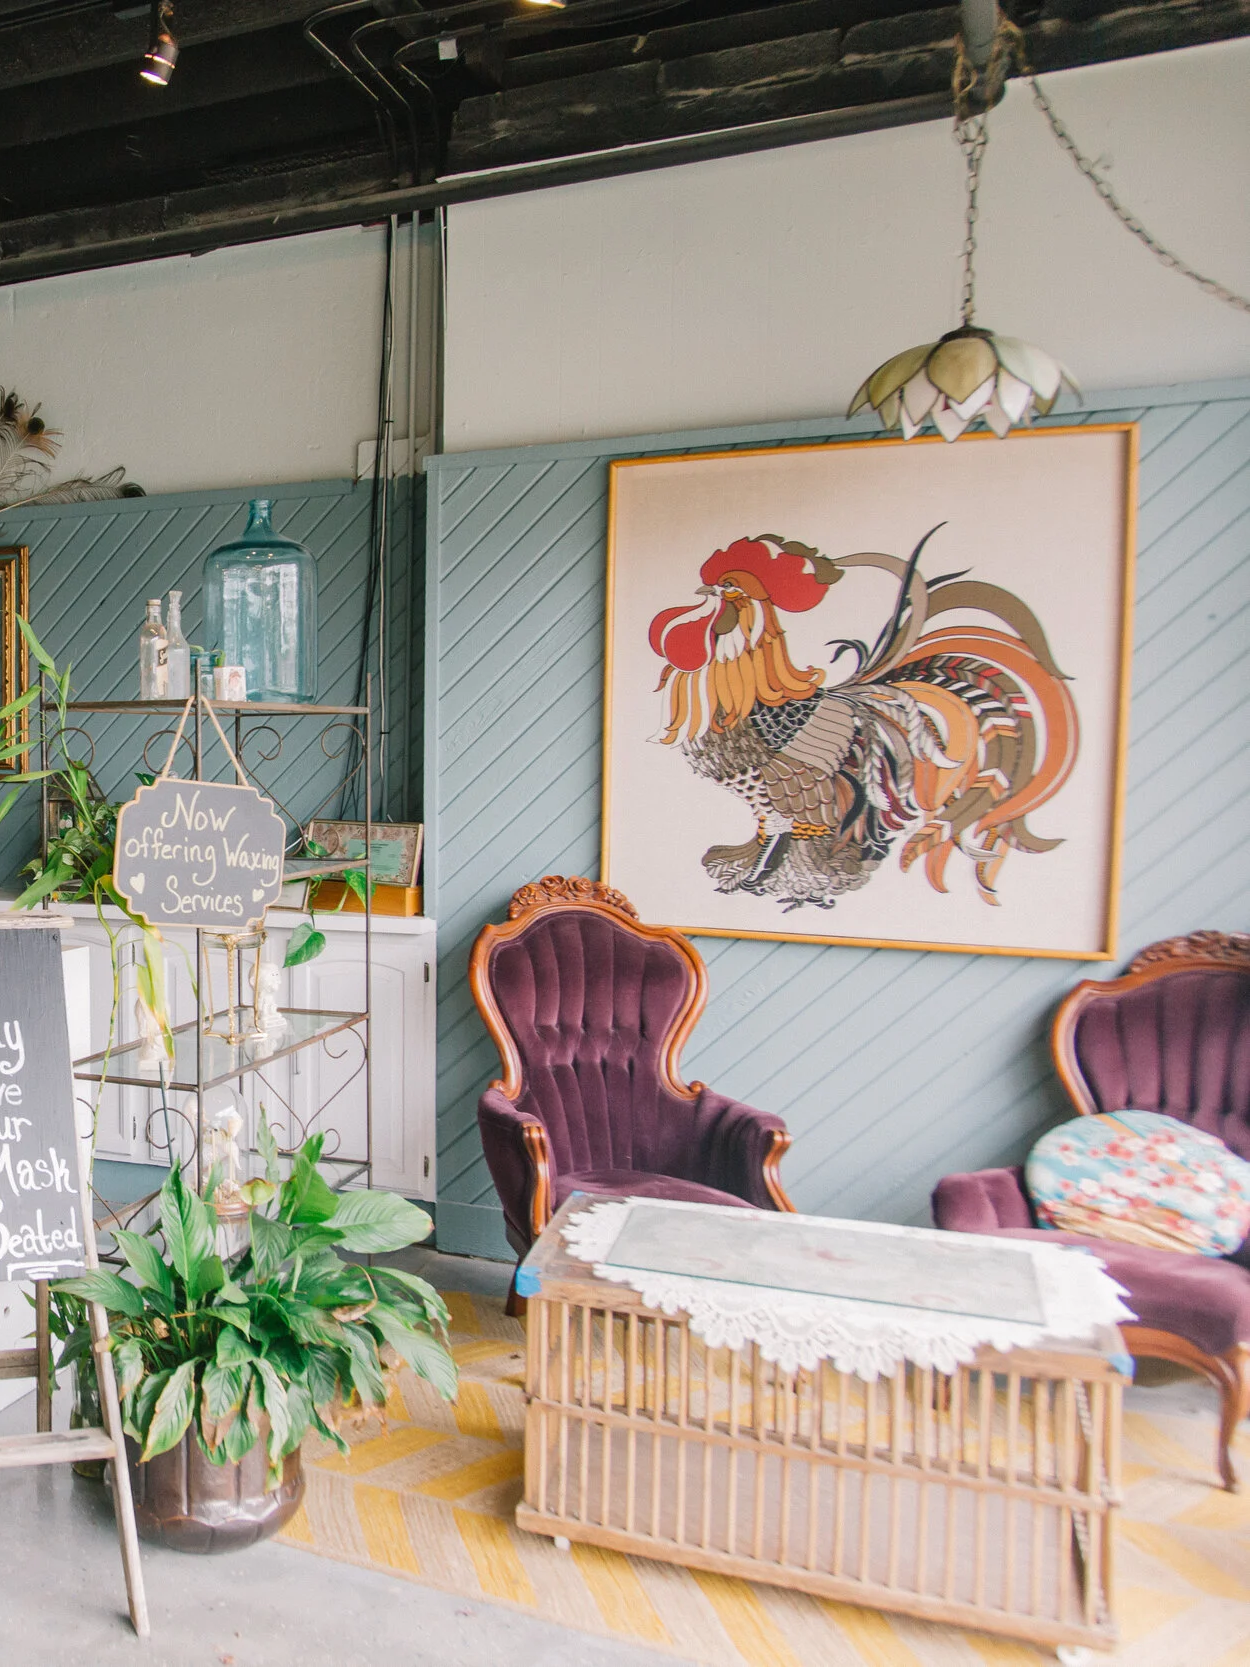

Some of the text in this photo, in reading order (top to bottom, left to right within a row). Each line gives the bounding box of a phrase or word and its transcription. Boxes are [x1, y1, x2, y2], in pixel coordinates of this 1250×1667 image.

[161, 790, 236, 832] Now
[223, 833, 279, 887] Waxing
[161, 875, 243, 917] Services
